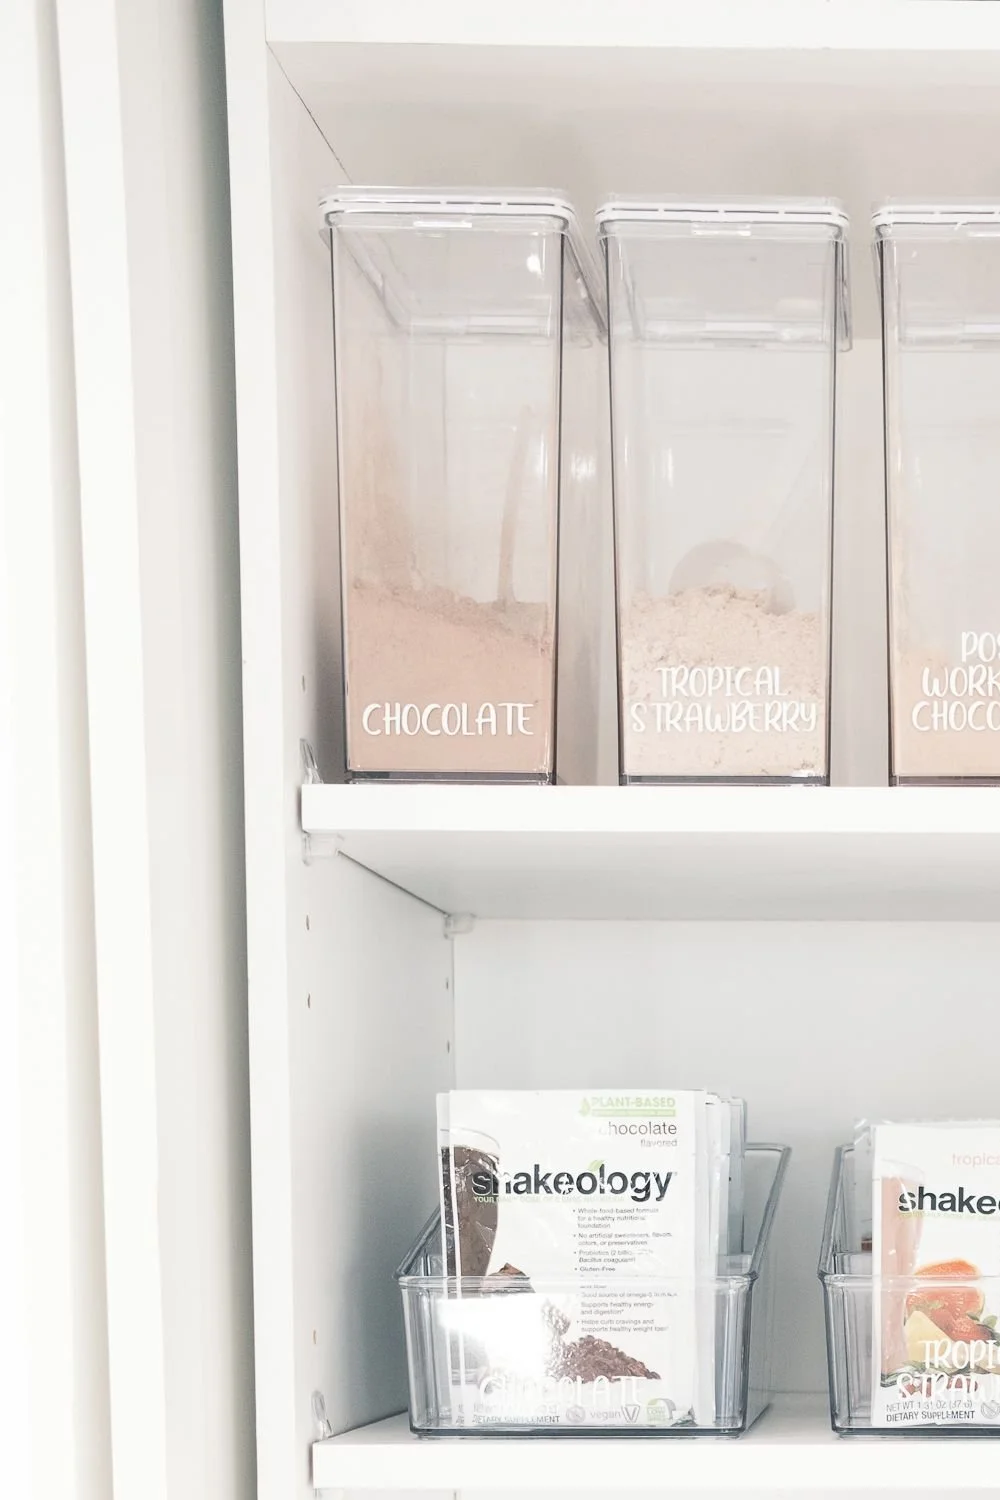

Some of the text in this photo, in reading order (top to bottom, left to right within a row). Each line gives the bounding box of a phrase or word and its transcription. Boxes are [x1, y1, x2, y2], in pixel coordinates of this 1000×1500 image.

[654, 666, 788, 697] TROPICAL
[362, 702, 535, 736] CHOCOLATE
[629, 700, 818, 733] STRAWBERRY
[591, 1097, 677, 1108] PLANT-BASED
[640, 1139, 678, 1148] flavored
[472, 1164, 673, 1203] shakeology
[481, 1375, 647, 1406] COLATE
[590, 1409, 621, 1421] vegan
[885, 1409, 977, 1423] DIETARY SUPPLEMENT
[886, 1402, 902, 1412] NET
